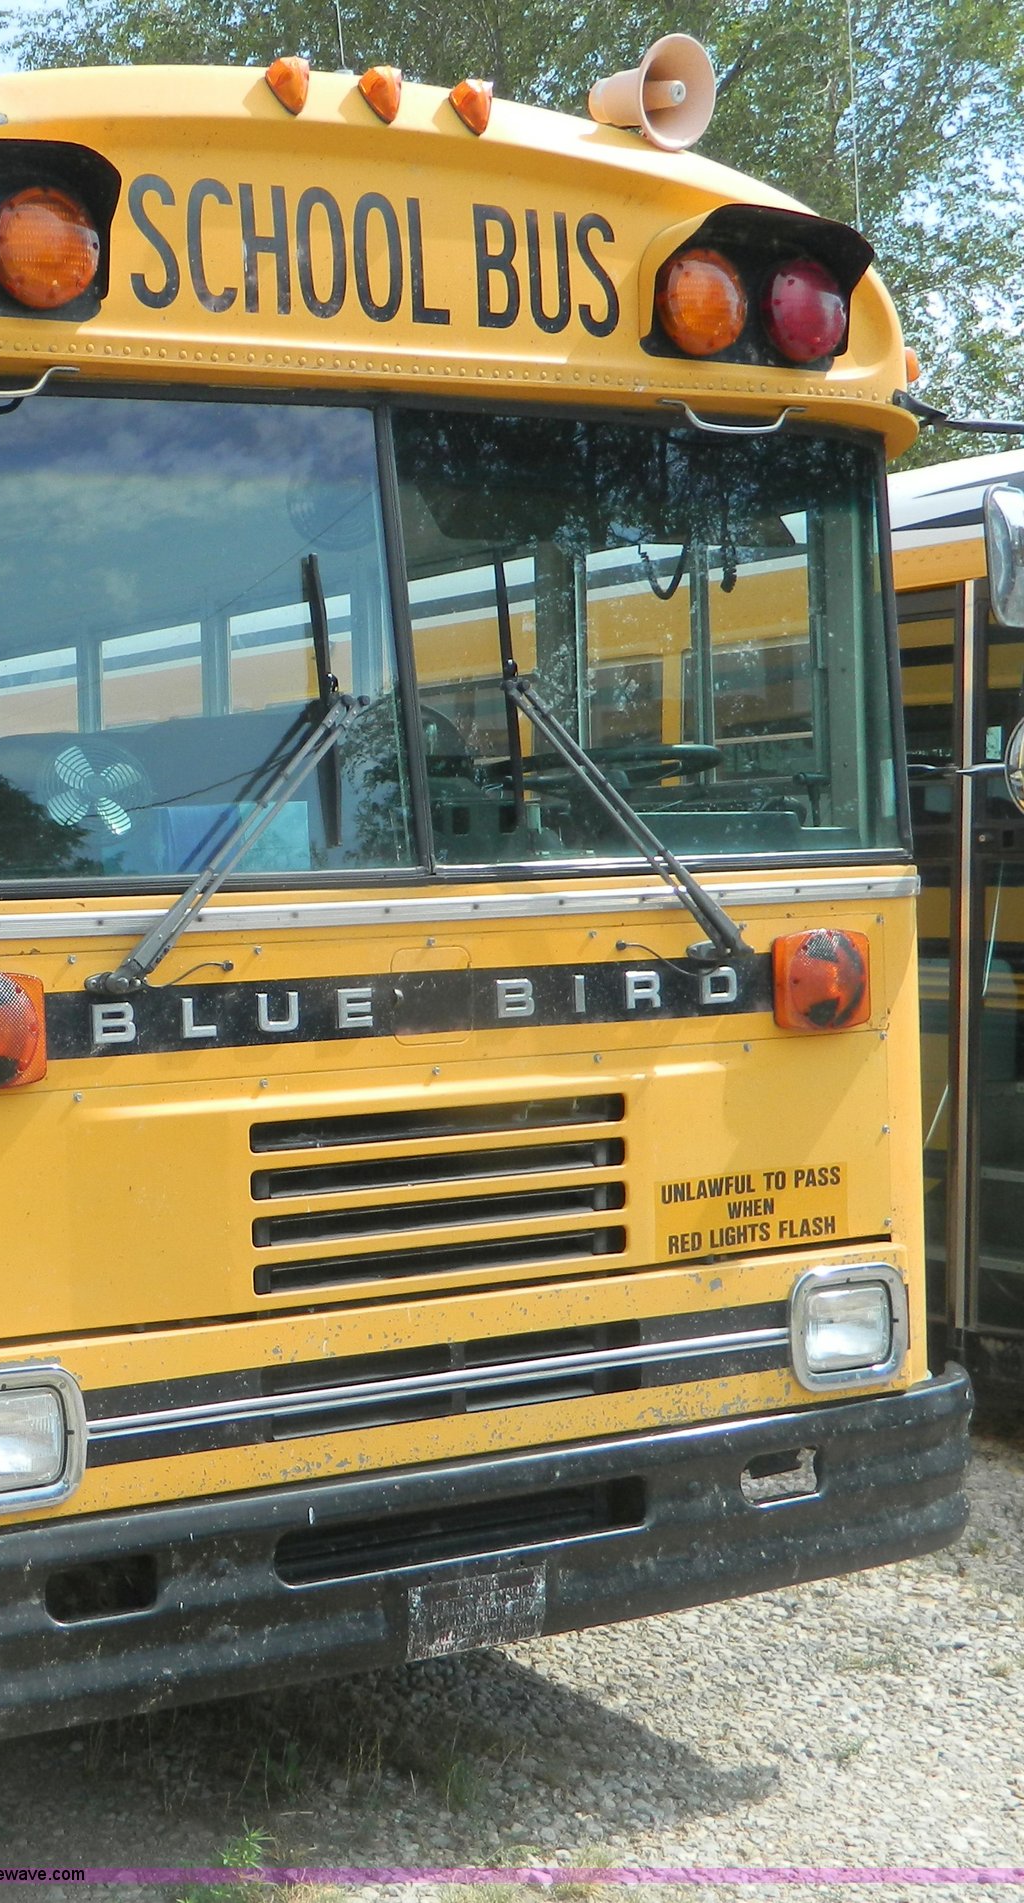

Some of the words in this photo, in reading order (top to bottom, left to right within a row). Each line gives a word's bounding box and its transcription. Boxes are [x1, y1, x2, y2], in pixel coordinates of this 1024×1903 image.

[127, 173, 451, 326] SCHOOL
[472, 203, 620, 339] BUS
[91, 986, 375, 1045] BLUE
[496, 965, 739, 1020] BIRD
[661, 1174, 756, 1205] UNLAWFUL
[763, 1170, 786, 1192] TO
[794, 1165, 841, 1189] PASS
[727, 1197, 775, 1219] WHEN
[668, 1231, 703, 1255] RED
[709, 1222, 771, 1249] LIGHTS
[778, 1215, 836, 1239] FLASH
